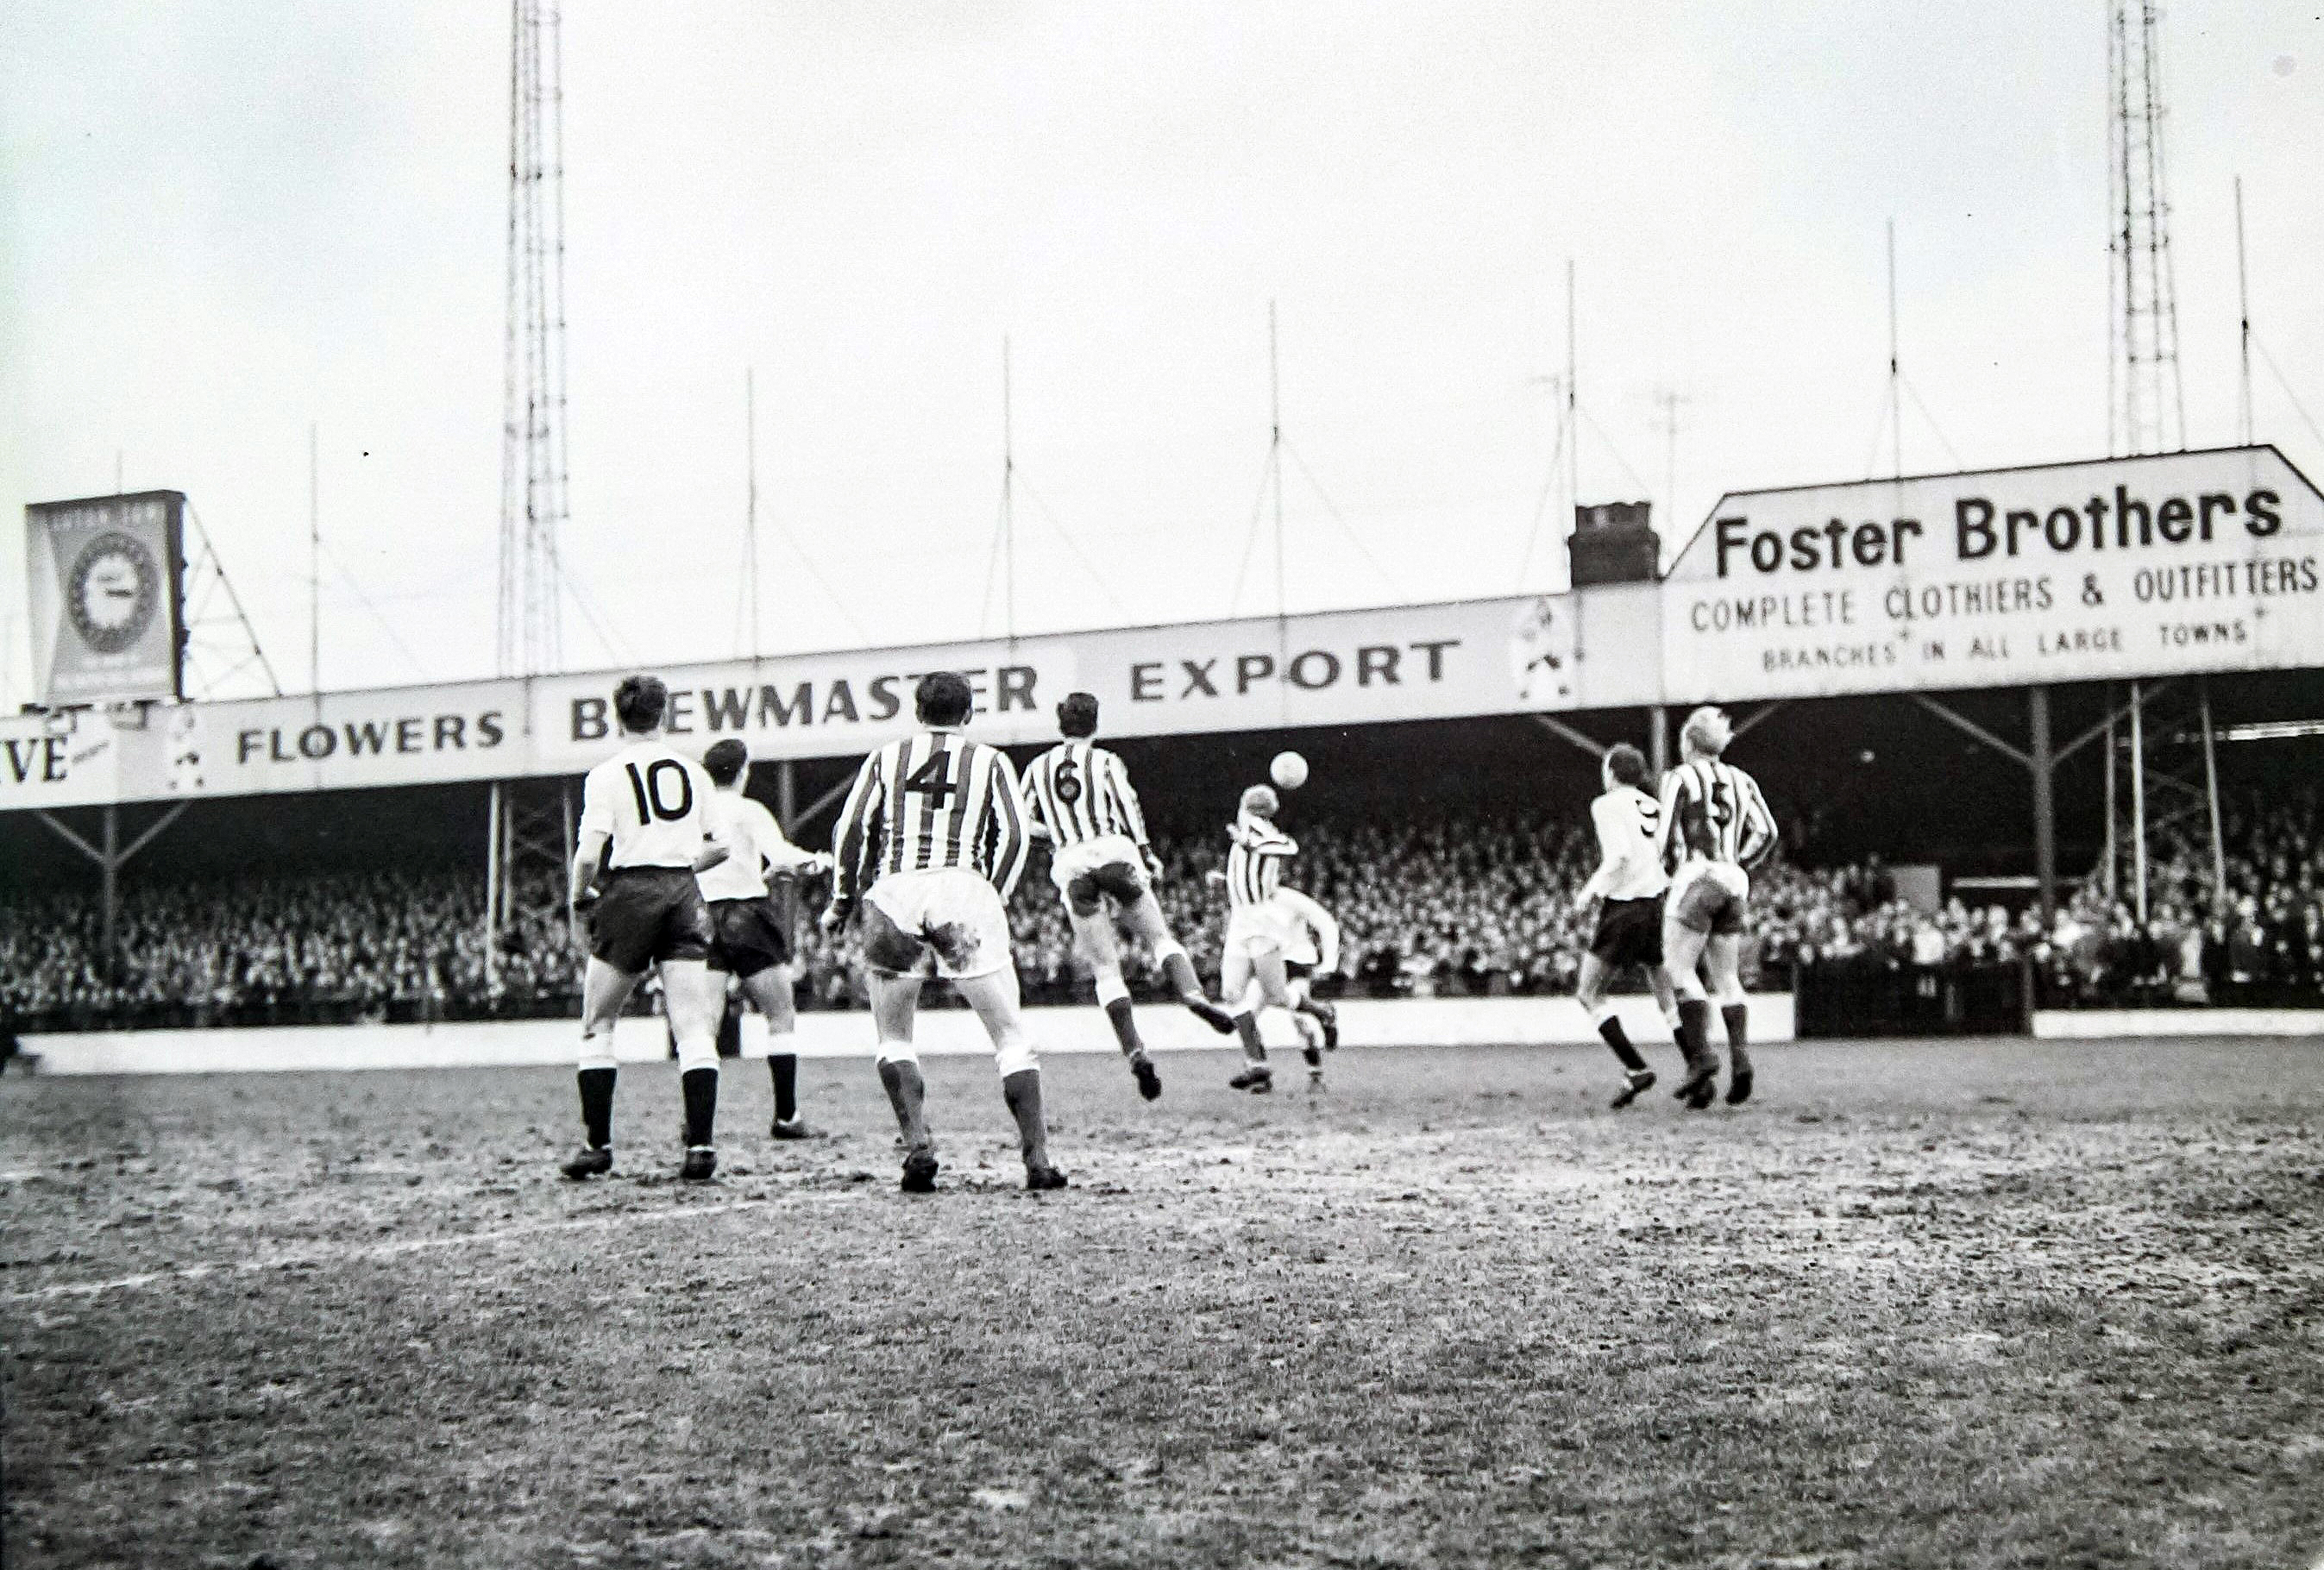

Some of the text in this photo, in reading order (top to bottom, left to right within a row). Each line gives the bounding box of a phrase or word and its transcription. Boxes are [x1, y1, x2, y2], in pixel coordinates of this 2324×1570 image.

[1715, 484, 2281, 579] Foster Brothers
[1690, 556, 2319, 632] COMPLETE CLOTHIERS & OUTFITTERS
[1762, 619, 2247, 673] BRANCHES IN ALL LARGE TOWNS
[236, 638, 1462, 765] FLOWERS BEWMASER EXPORT
[0, 736, 69, 783] VE
[906, 750, 958, 809] 4
[1054, 759, 1082, 803] 6
[625, 758, 692, 826] 10
